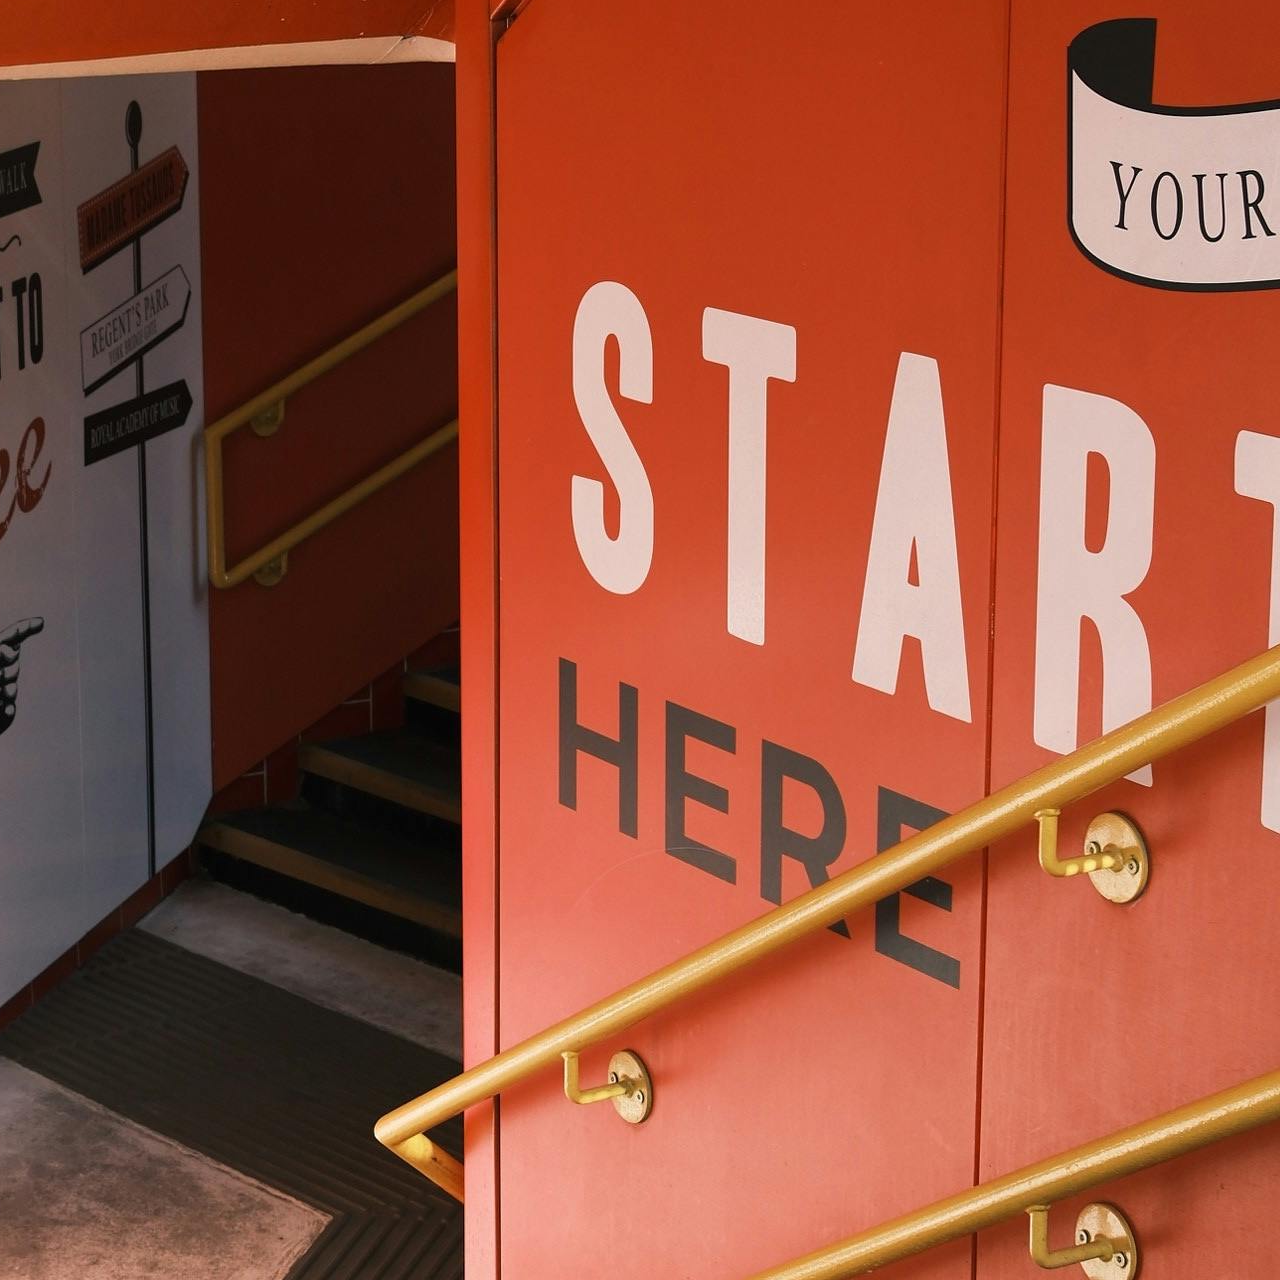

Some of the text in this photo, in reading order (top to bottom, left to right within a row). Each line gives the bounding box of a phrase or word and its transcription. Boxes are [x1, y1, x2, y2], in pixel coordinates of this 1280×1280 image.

[1109, 160, 1277, 243] YOUR
[12, 271, 44, 371] TO
[91, 283, 170, 358] REGENT'S PARK
[90, 395, 181, 449] ROYAL ACADEMY OF MUSIC
[558, 656, 961, 991] HERE
